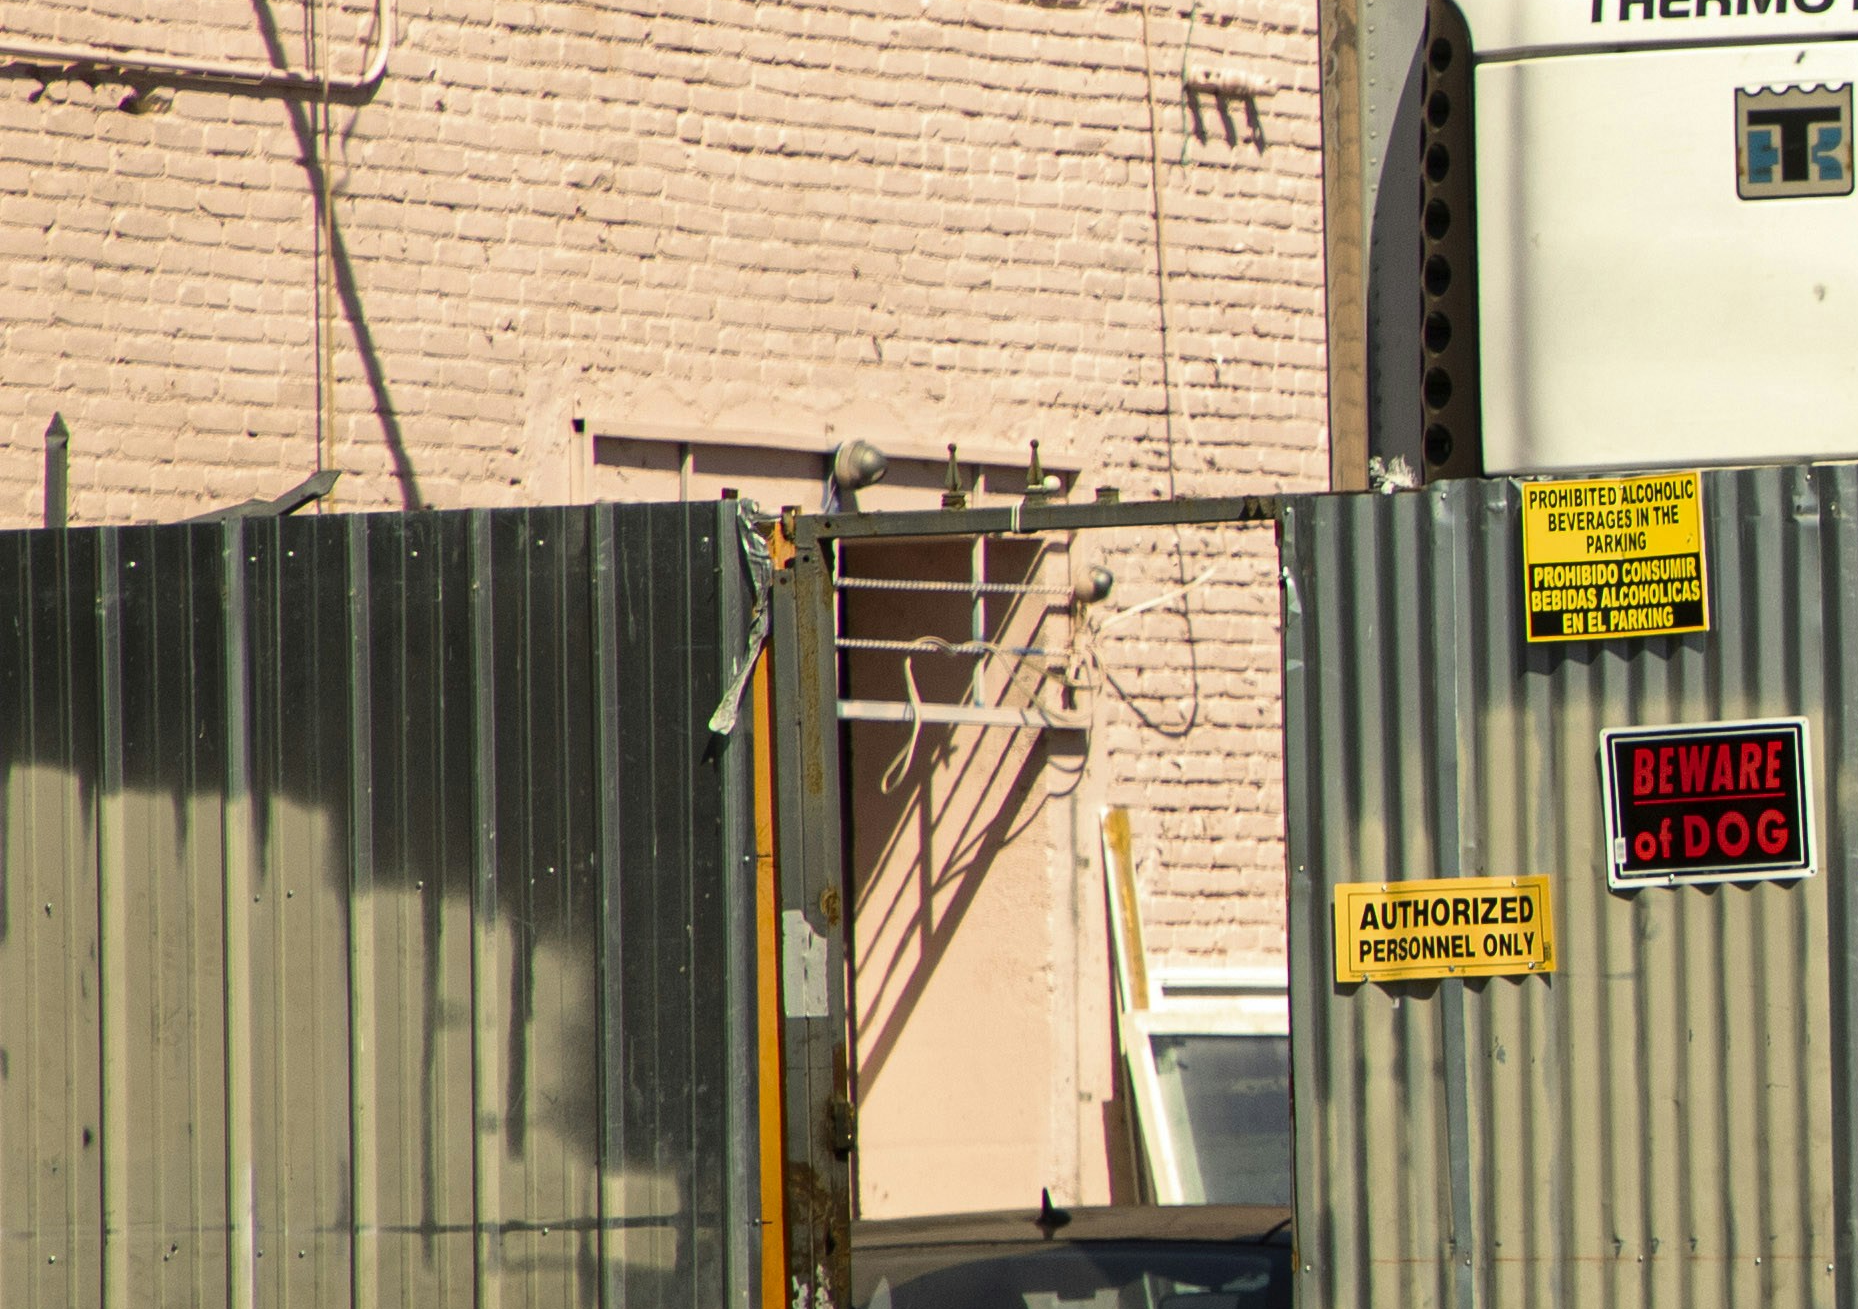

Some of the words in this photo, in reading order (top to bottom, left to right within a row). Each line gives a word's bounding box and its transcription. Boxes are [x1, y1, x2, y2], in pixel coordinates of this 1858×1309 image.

[1530, 486, 1616, 509] PROHIBITED
[1621, 480, 1694, 505] ALCOHOLIC
[1548, 510, 1632, 532] BEVERAGES
[1637, 508, 1650, 528] IN
[1653, 504, 1679, 525] THE
[1586, 532, 1646, 554] PARKING
[1534, 564, 1618, 588] PROHIBIDO
[1622, 557, 1697, 582] CONSUMIR
[1532, 589, 1597, 612] BEBIDAS
[1601, 580, 1701, 608] ALCOHOLICAS
[1562, 612, 1583, 634] EN
[1588, 611, 1606, 633] EL
[1610, 606, 1674, 631] PARKING
[1633, 741, 1784, 796] BEWARE
[1633, 818, 1673, 861] of
[1683, 808, 1789, 858] DOG
[1359, 895, 1534, 930] AUTHORIZED
[1359, 934, 1476, 963] PERSONNEL
[1483, 931, 1535, 957] ONLY
